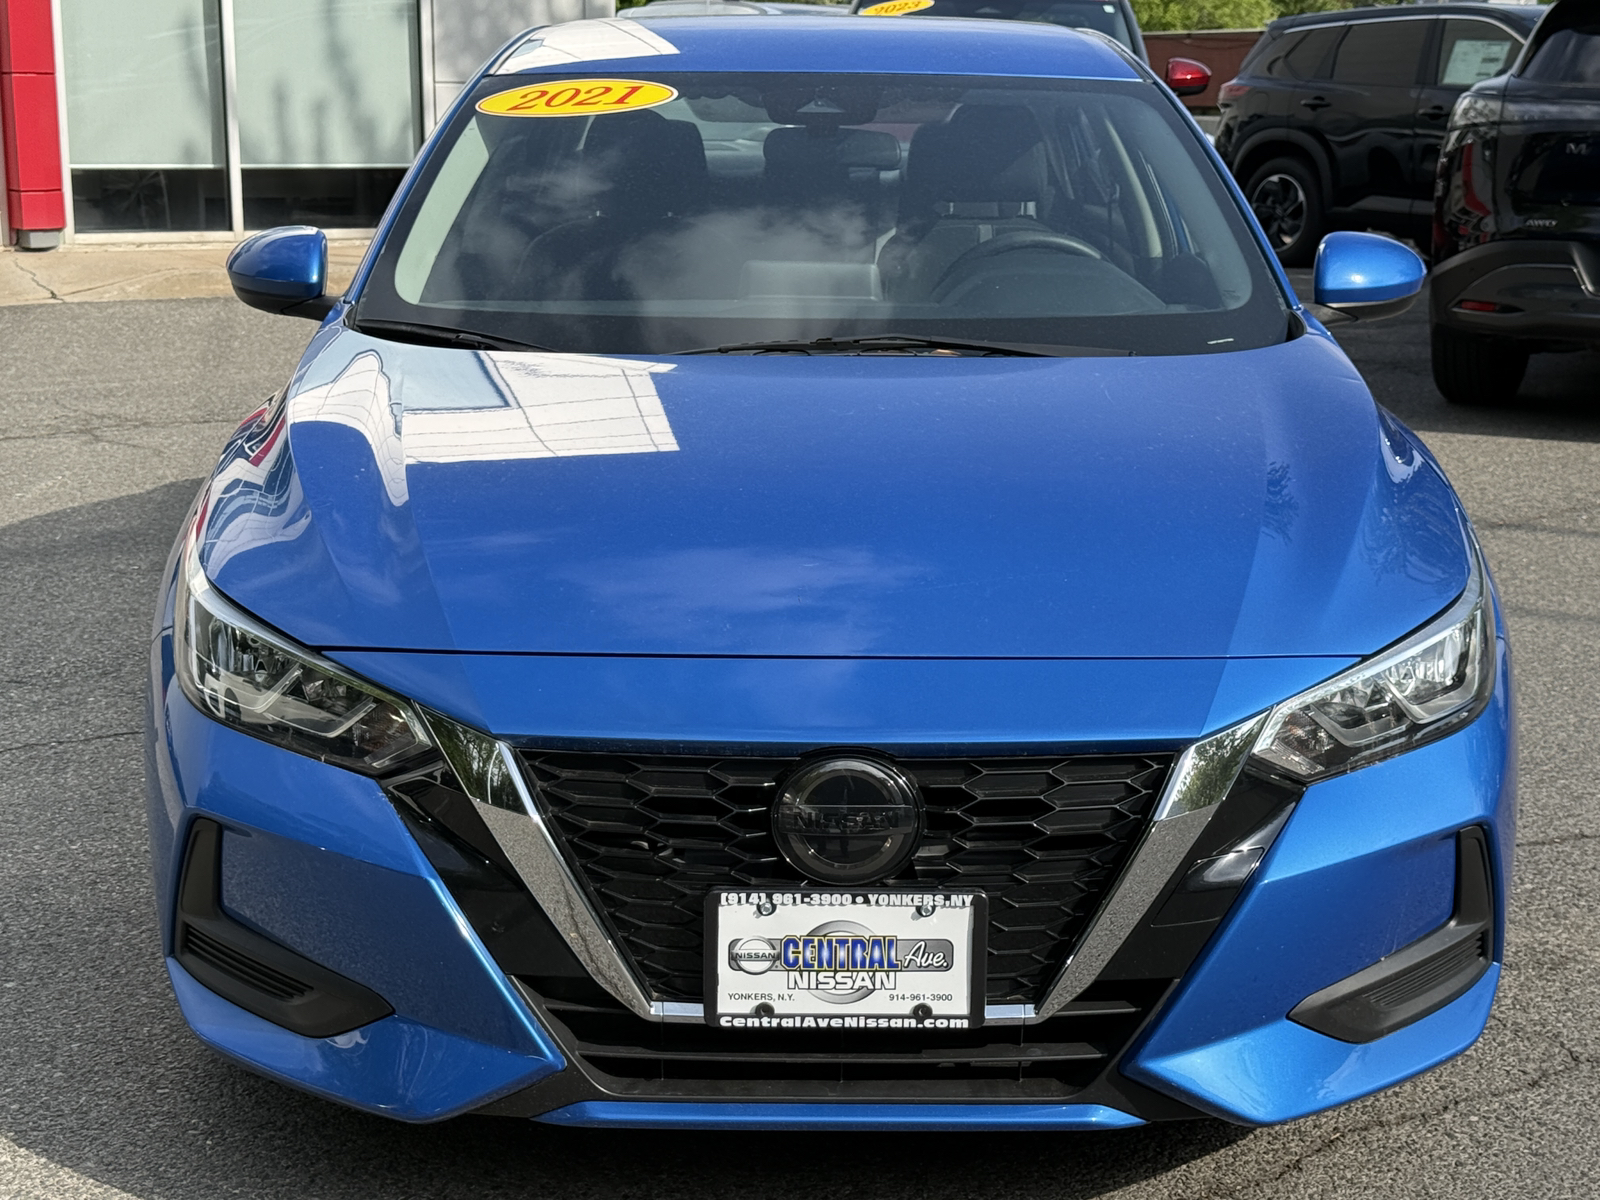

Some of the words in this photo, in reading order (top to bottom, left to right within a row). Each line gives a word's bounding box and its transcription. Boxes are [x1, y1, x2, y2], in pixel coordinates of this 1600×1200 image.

[506, 86, 644, 111] 2021
[793, 811, 899, 829] NISSAN
[772, 893, 852, 906] 961-3900
[780, 935, 902, 971] CENTRAL
[904, 940, 948, 968] Ave.
[787, 971, 896, 990] NISSAN
[728, 993, 776, 1002] YONKERS,
[778, 993, 795, 1001] N.Y.
[889, 993, 952, 1001] 914-961-3900
[720, 1016, 969, 1028] CentralAveNissan.com
